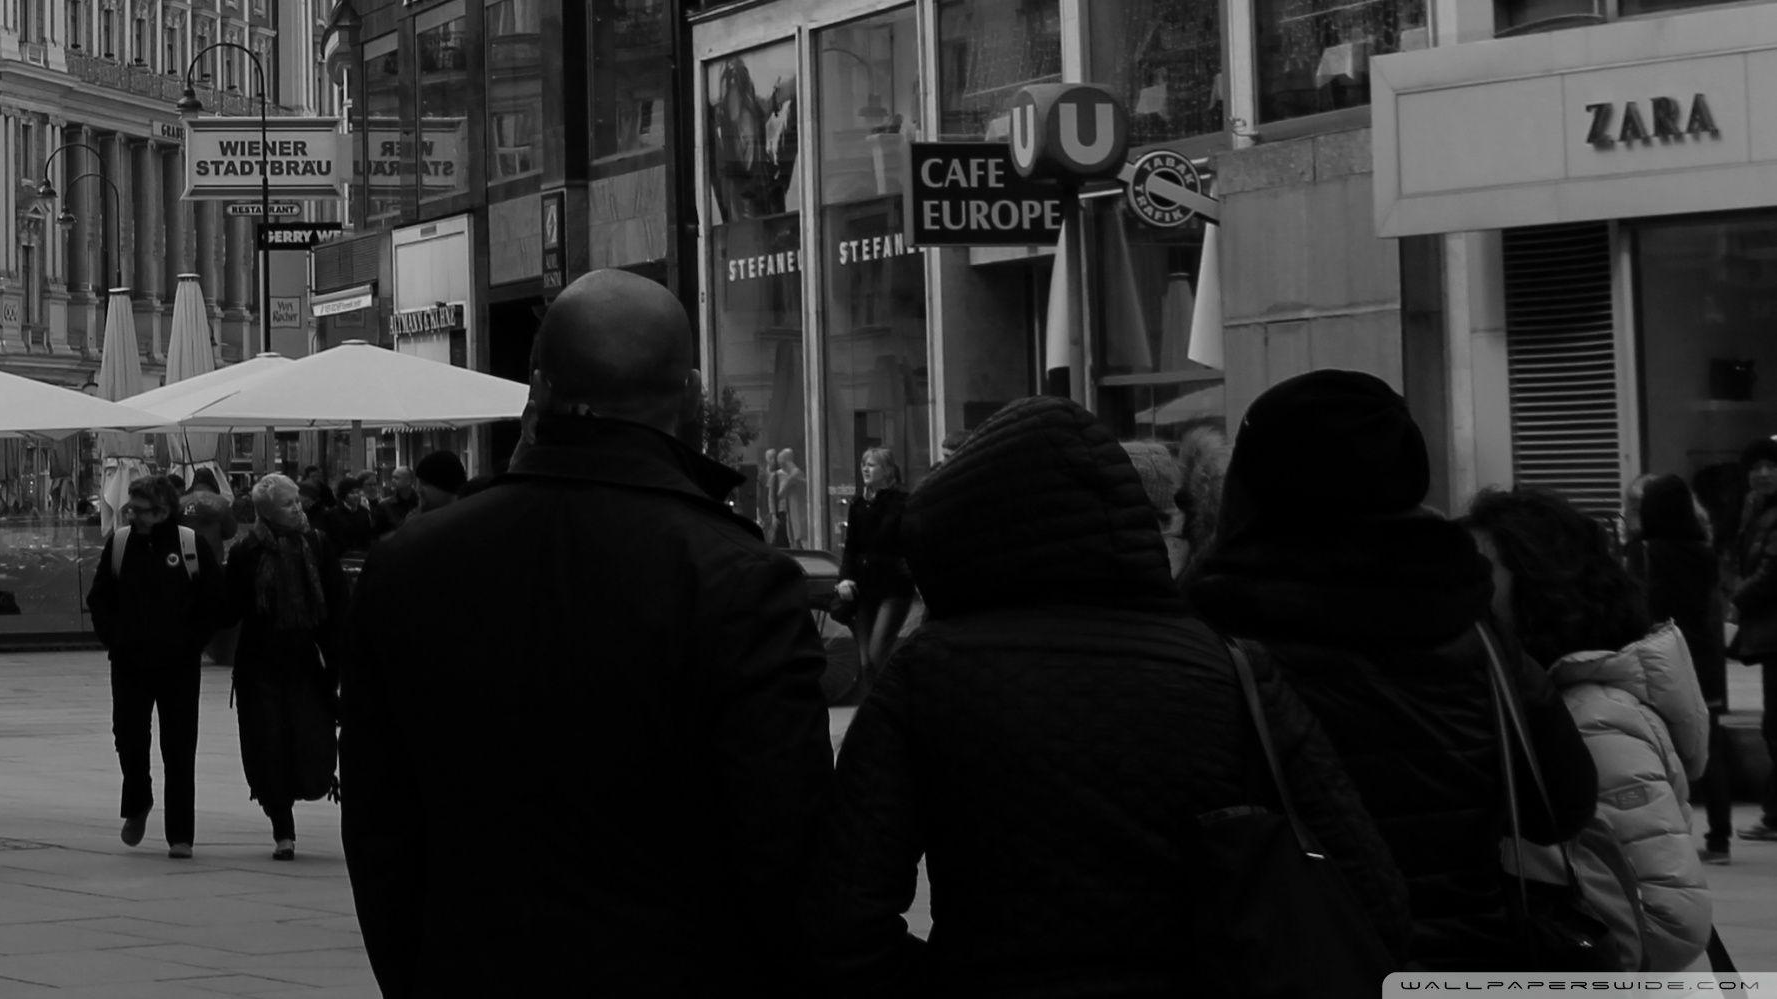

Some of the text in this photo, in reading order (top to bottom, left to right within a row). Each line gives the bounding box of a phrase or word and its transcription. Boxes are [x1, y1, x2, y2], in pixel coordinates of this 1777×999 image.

[1059, 103, 1115, 165] U
[1585, 93, 1722, 146] ZARA
[219, 141, 307, 156] WIENER
[1012, 104, 1035, 168] U
[196, 160, 332, 177] STADTBRÄU
[920, 157, 1005, 189] CAFE
[1144, 157, 1195, 184] TABAK
[232, 206, 295, 214] RESTARANT
[921, 199, 1061, 231] EUROPE
[1135, 185, 1183, 222] TRAFIK
[839, 233, 927, 265] STEFAN
